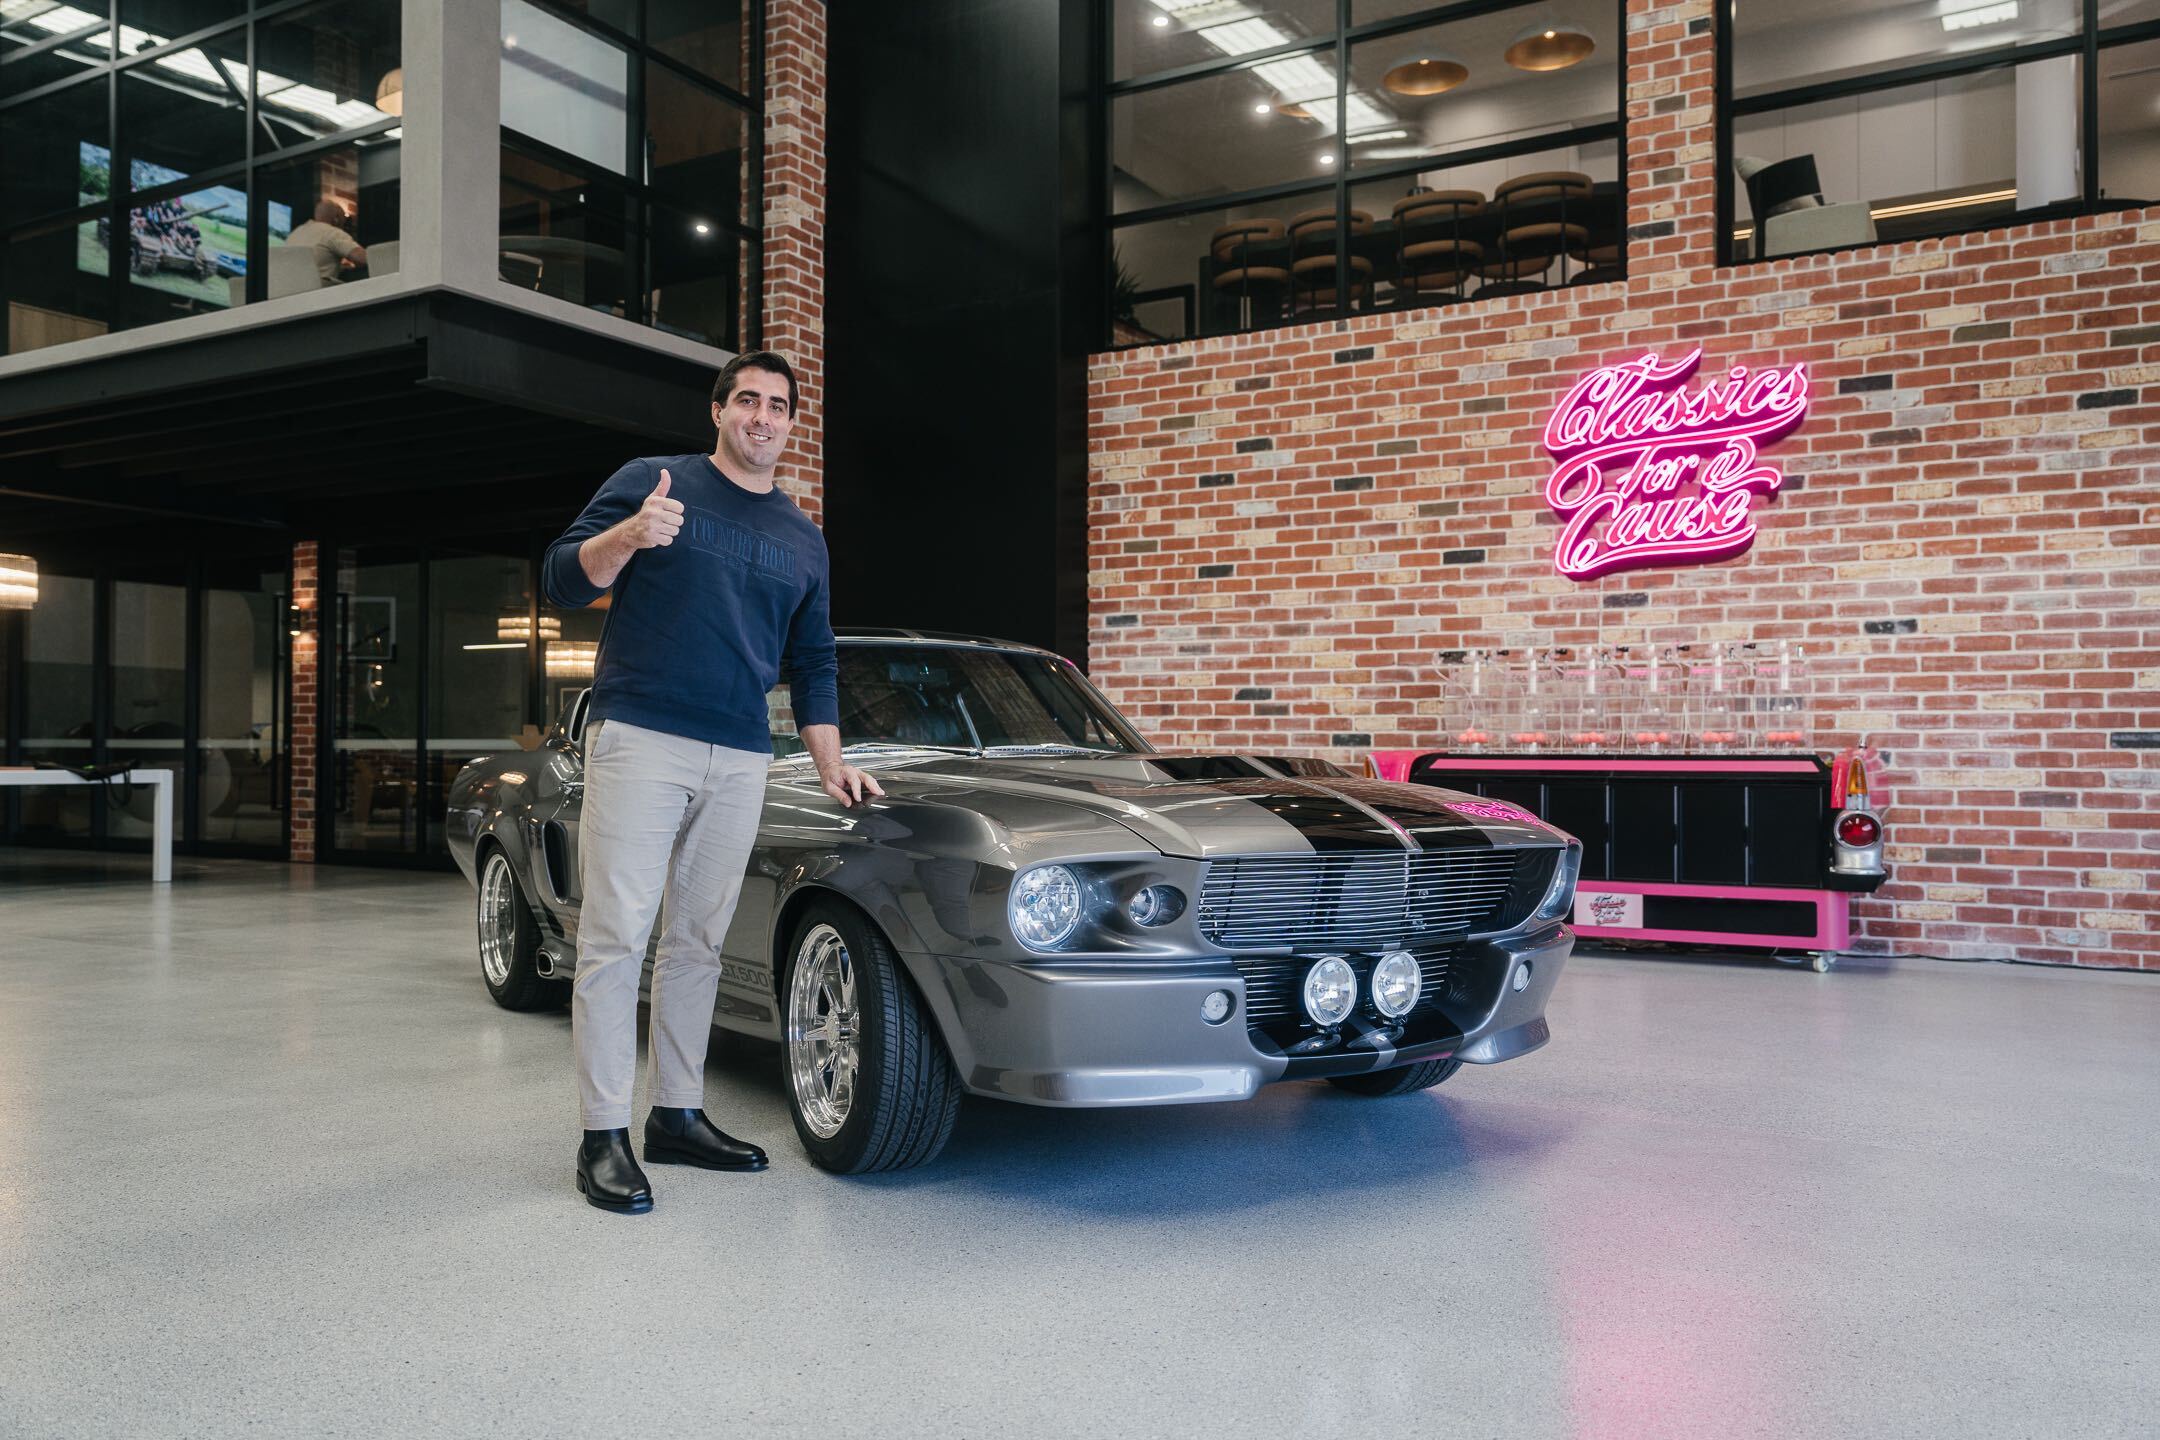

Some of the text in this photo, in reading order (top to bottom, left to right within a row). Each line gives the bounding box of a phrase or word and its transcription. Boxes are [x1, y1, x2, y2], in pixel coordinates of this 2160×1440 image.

[1544, 347, 1808, 452] Classics
[691, 514, 757, 563] COUNTRY
[758, 538, 796, 579] ROAD
[1554, 488, 1758, 573] Cause
